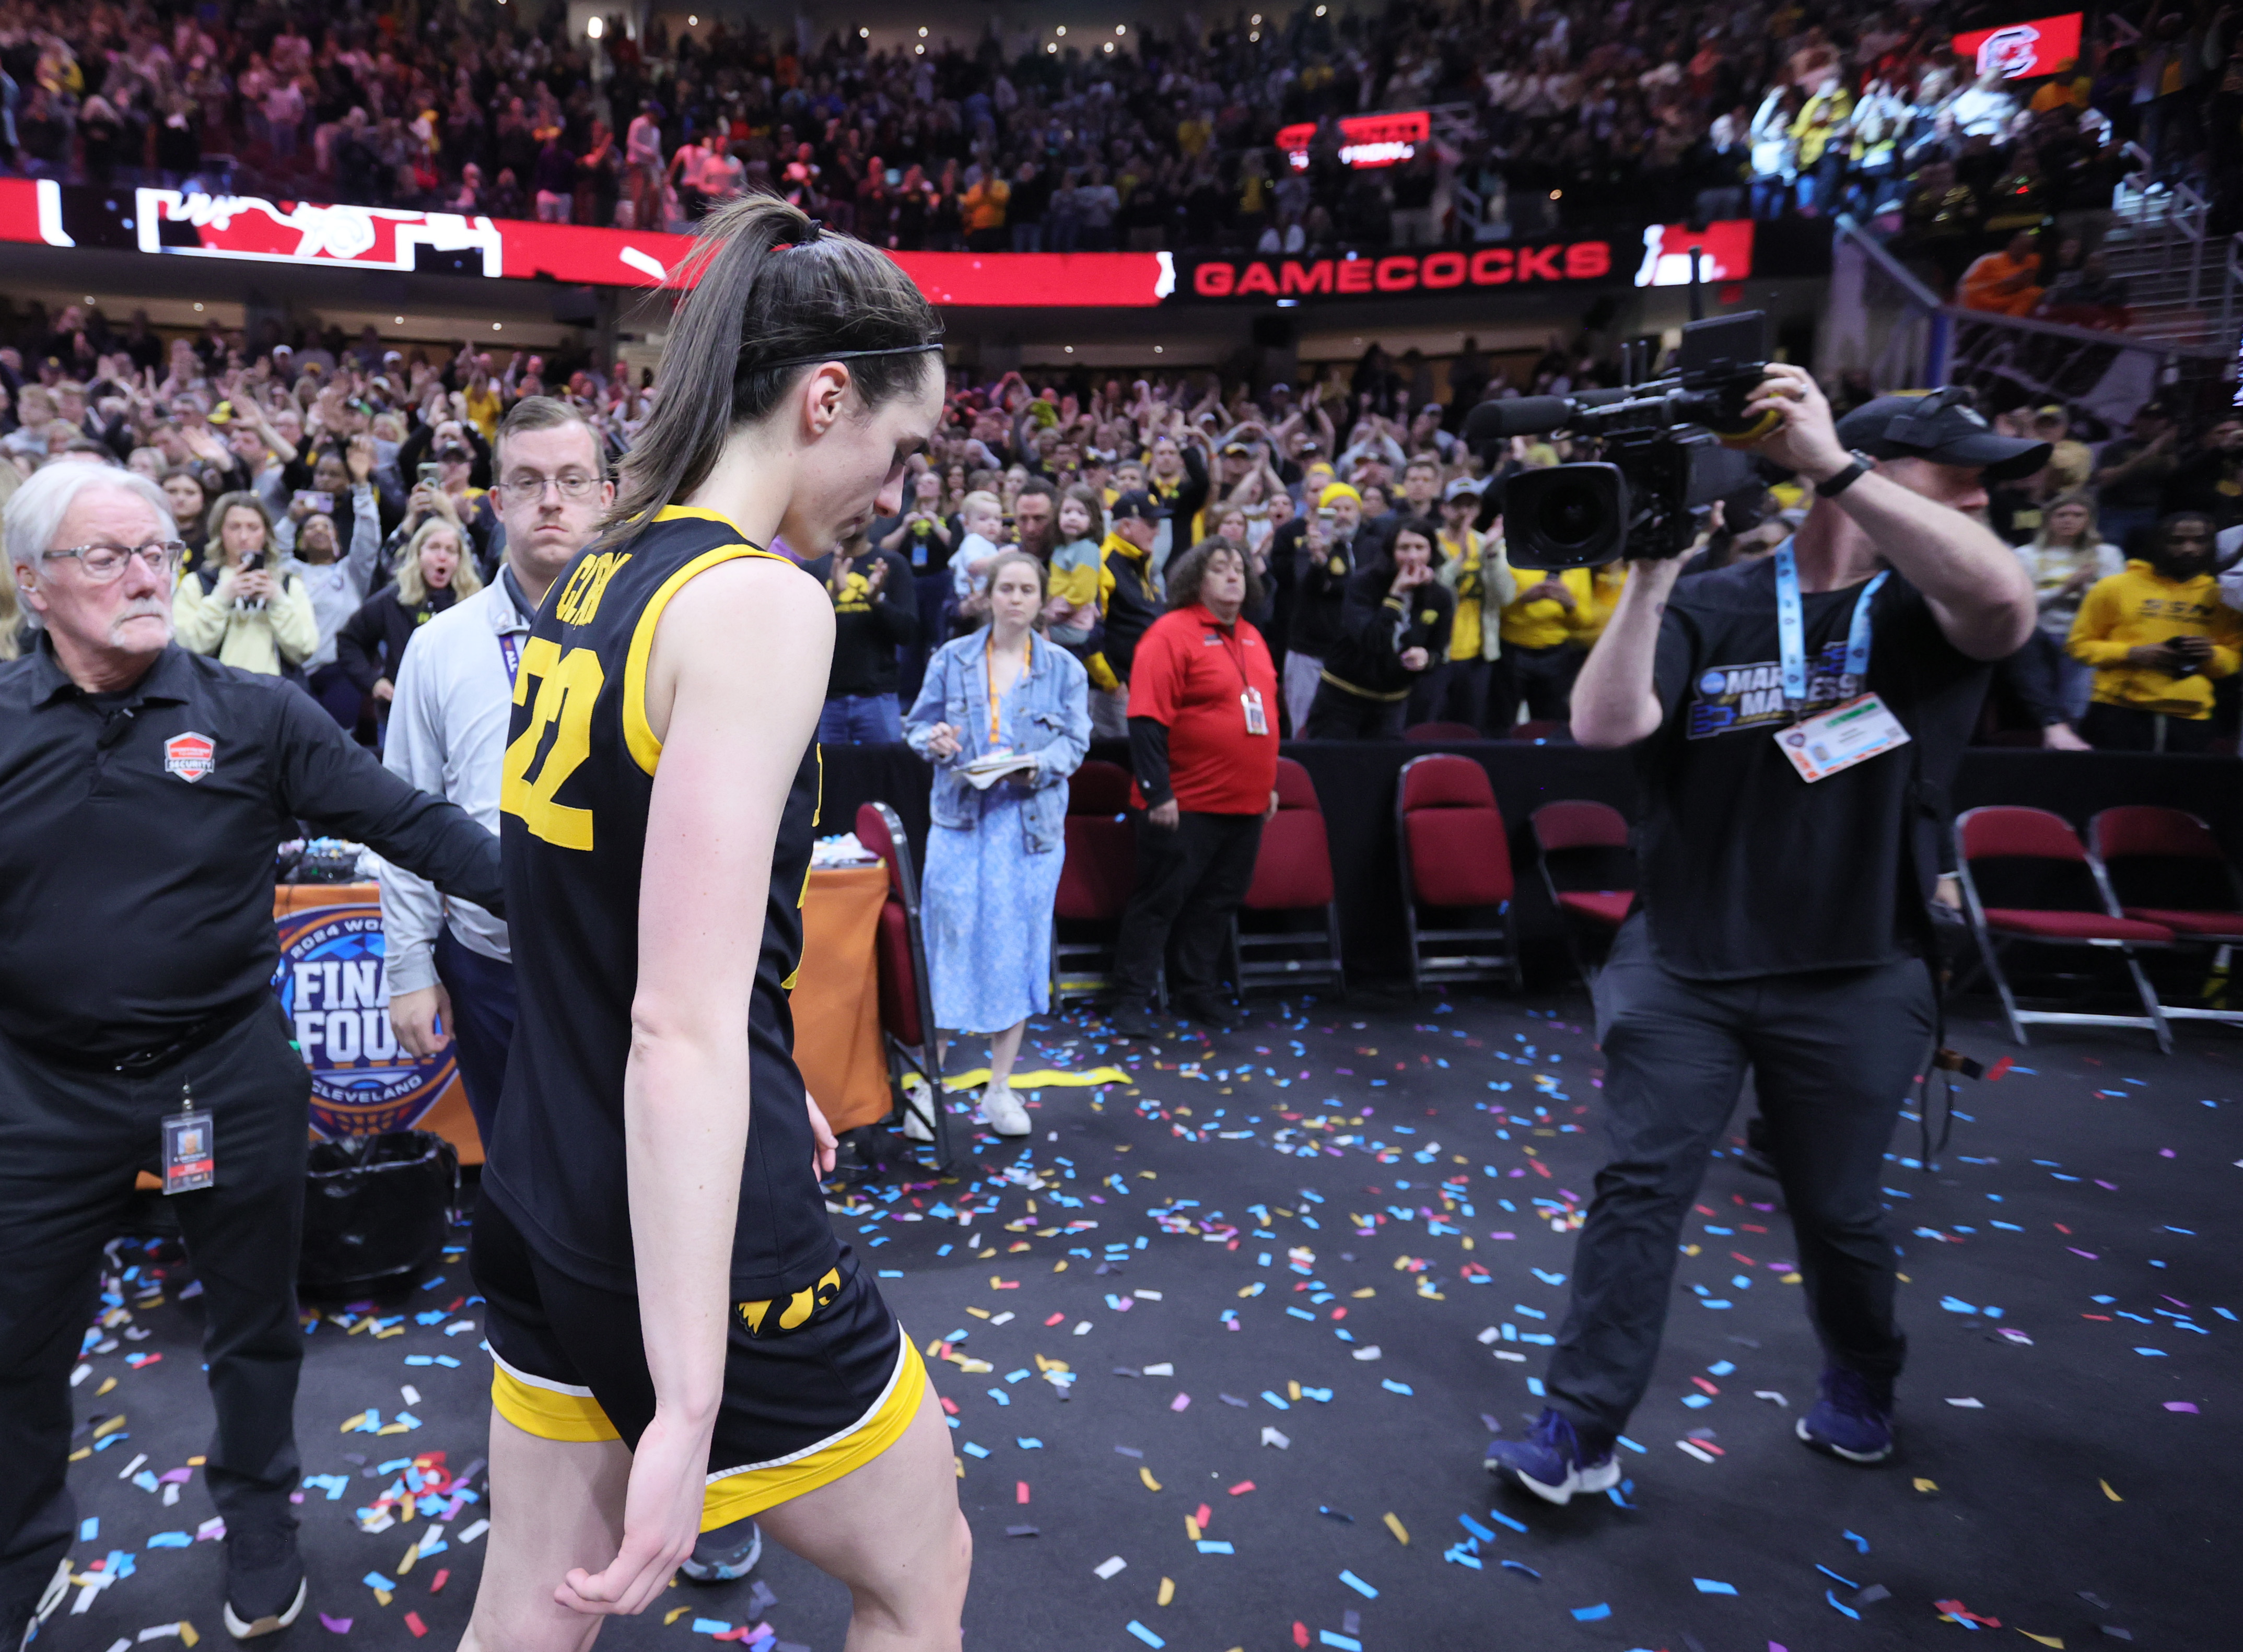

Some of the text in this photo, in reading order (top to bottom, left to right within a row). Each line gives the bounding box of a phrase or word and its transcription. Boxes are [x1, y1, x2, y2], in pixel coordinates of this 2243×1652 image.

[1194, 241, 1611, 296] GAMECOCKS
[169, 760, 211, 769] SECURITY
[500, 636, 604, 851] 22
[290, 920, 384, 959] 2024 WO
[293, 1008, 414, 1063] FOU
[312, 1074, 423, 1103] CLEVELAND
